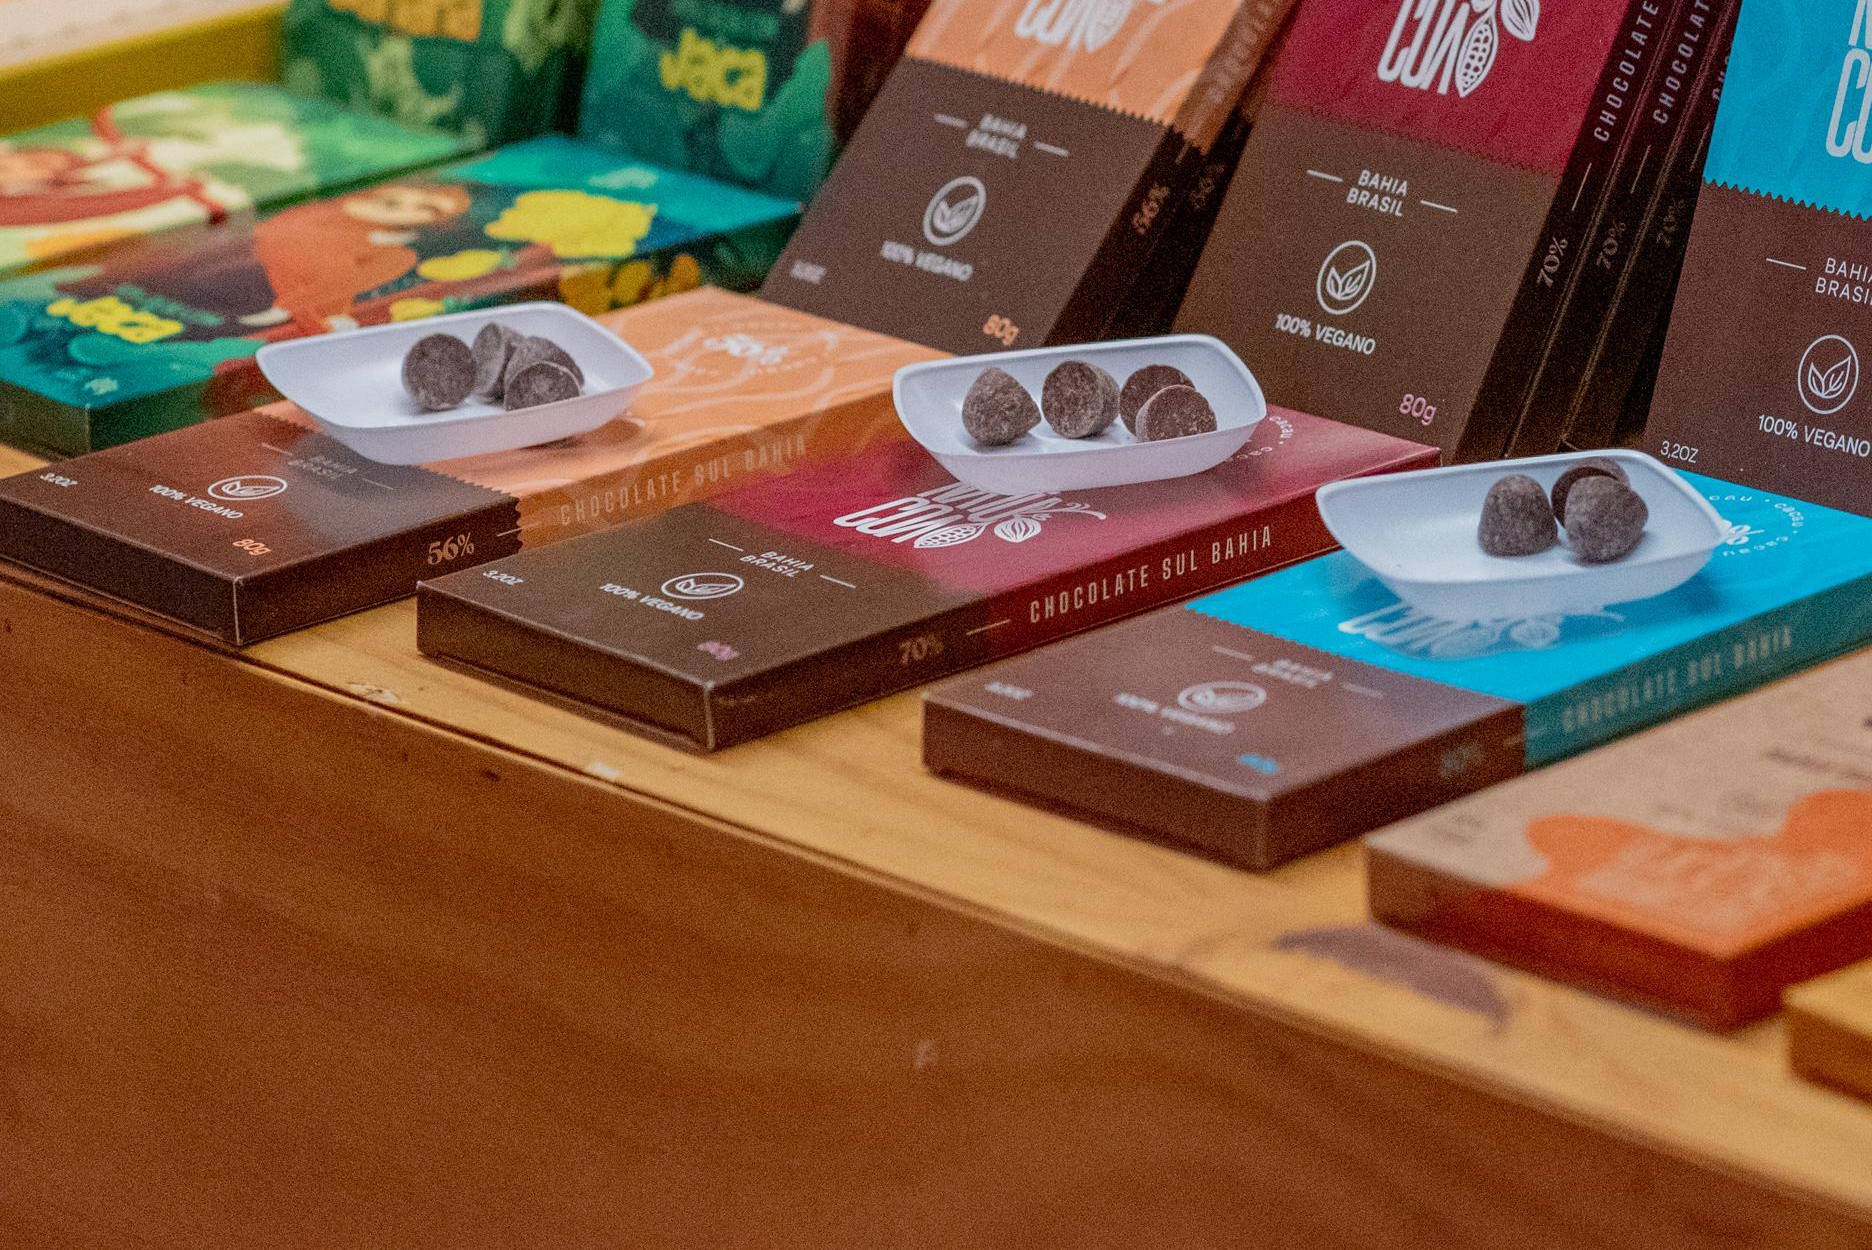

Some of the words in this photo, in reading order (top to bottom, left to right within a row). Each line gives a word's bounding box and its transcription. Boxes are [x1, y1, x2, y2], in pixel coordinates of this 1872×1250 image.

[1593, 0, 1660, 143] CHOCOLATE
[1357, 168, 1409, 197] BAHIA
[1345, 188, 1404, 218] BRASIL
[1536, 236, 1570, 288] 70%
[1595, 219, 1628, 270] 70%
[1273, 313, 1312, 339] 100%
[1315, 323, 1377, 356] VEGANO
[1399, 392, 1437, 426] 80g
[1660, 439, 1700, 465] 3,2OZ
[1757, 413, 1799, 441] 100%
[1803, 424, 1872, 459] VEGANO
[558, 470, 684, 527] CHOCOLATE
[694, 458, 733, 489] SUL
[744, 436, 808, 472] BAHIA
[1708, 494, 1753, 502] cau
[148, 484, 184, 501] 100%
[184, 497, 245, 520] VEGANO
[833, 496, 965, 545] COA
[231, 538, 273, 556] 80g
[426, 531, 476, 566] 56%
[759, 550, 816, 573] BAHIA
[739, 554, 801, 579] BRASIL
[1029, 564, 1150, 624] CHOCOLATE
[1162, 549, 1199, 581] SUL
[1210, 525, 1273, 565] BAHIA
[599, 581, 640, 601] 100%
[639, 594, 705, 622] VEGANO
